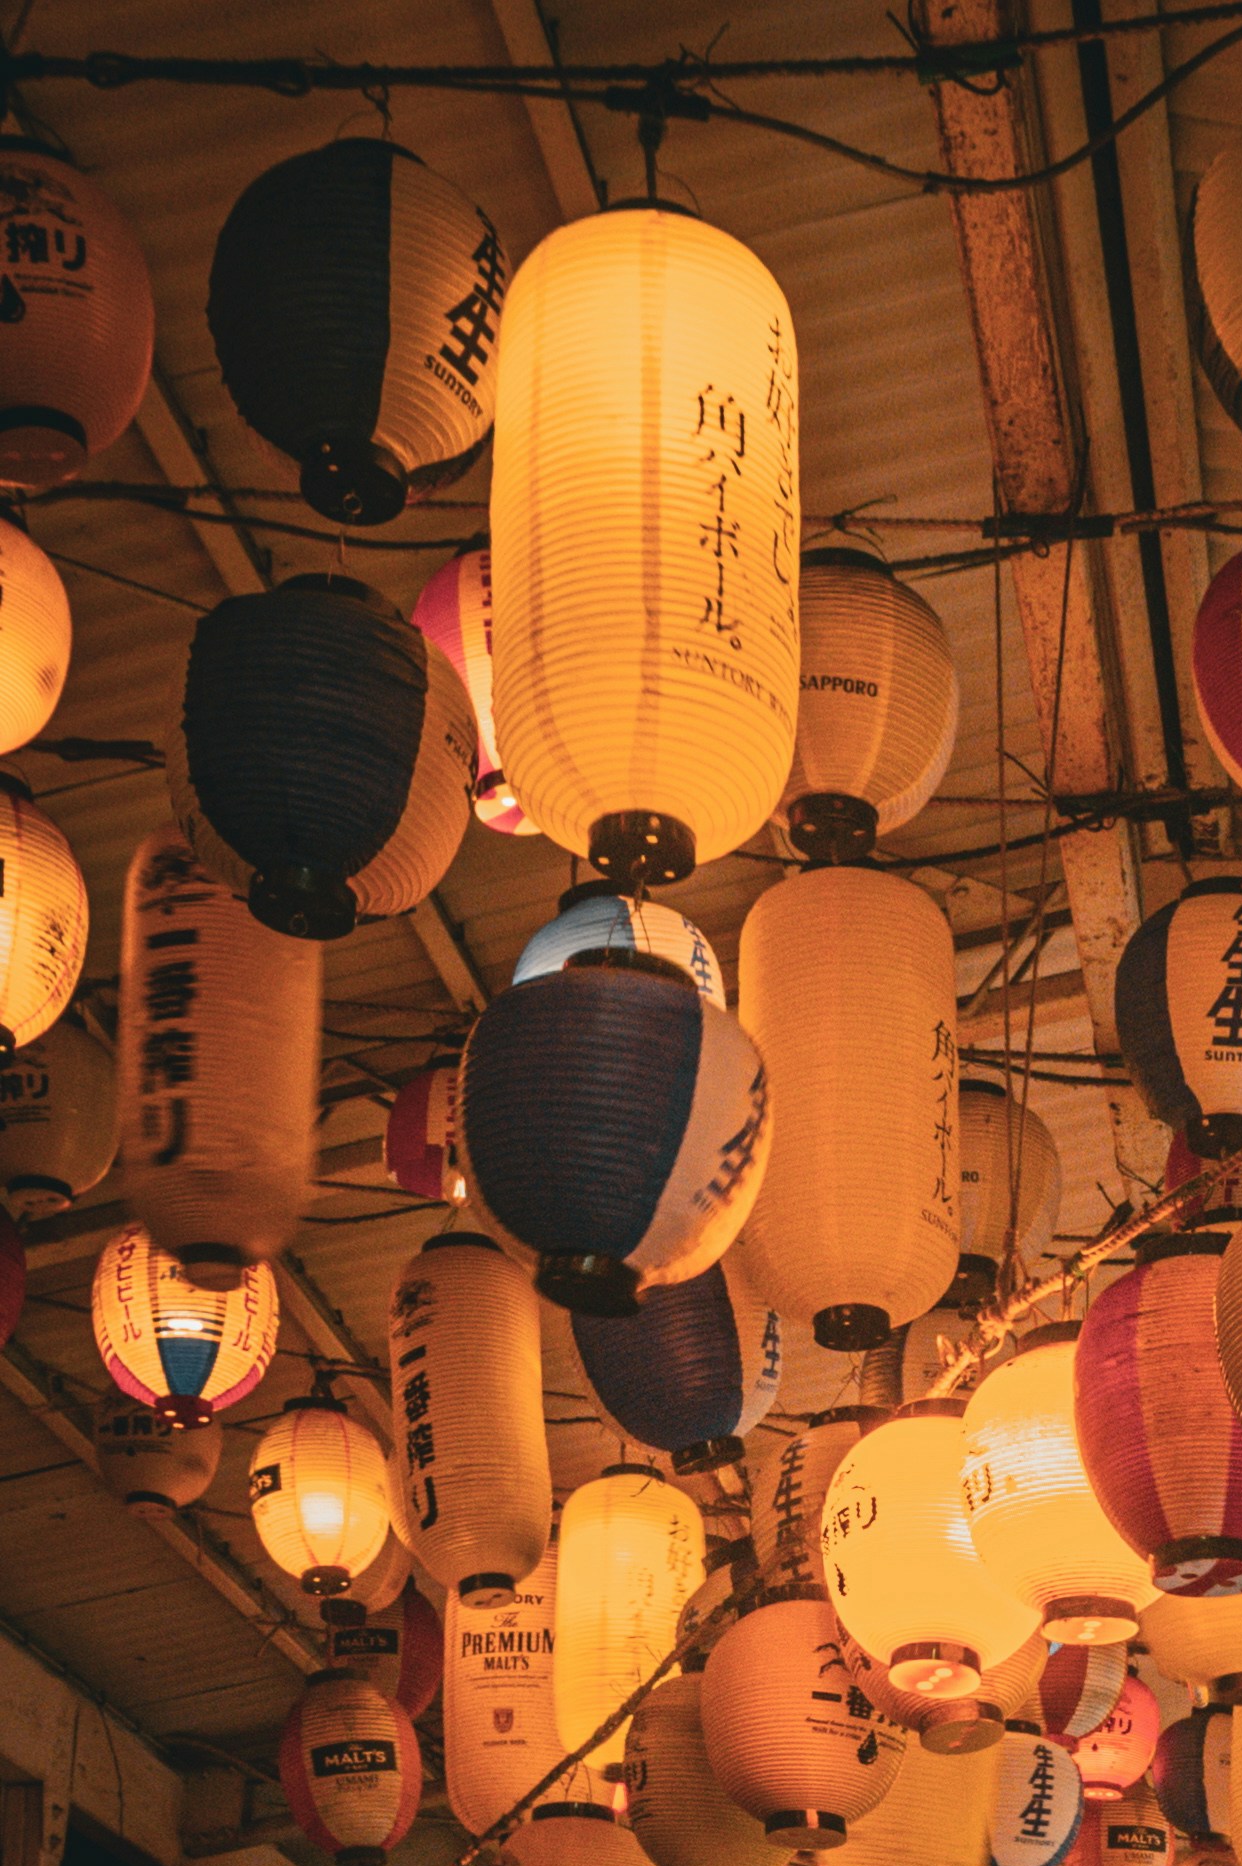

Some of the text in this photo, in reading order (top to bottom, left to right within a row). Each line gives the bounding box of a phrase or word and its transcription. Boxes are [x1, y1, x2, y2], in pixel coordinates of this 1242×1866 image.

[799, 672, 880, 698] SAPPORO
[398, 1343, 440, 1532] 一番搾り
[339, 1633, 389, 1649] MALT'S
[483, 1655, 530, 1672] MALT'S
[324, 1749, 387, 1769] MALT'S
[1018, 1743, 1055, 1838] 生生生
[1117, 1832, 1161, 1847] MALT'S
